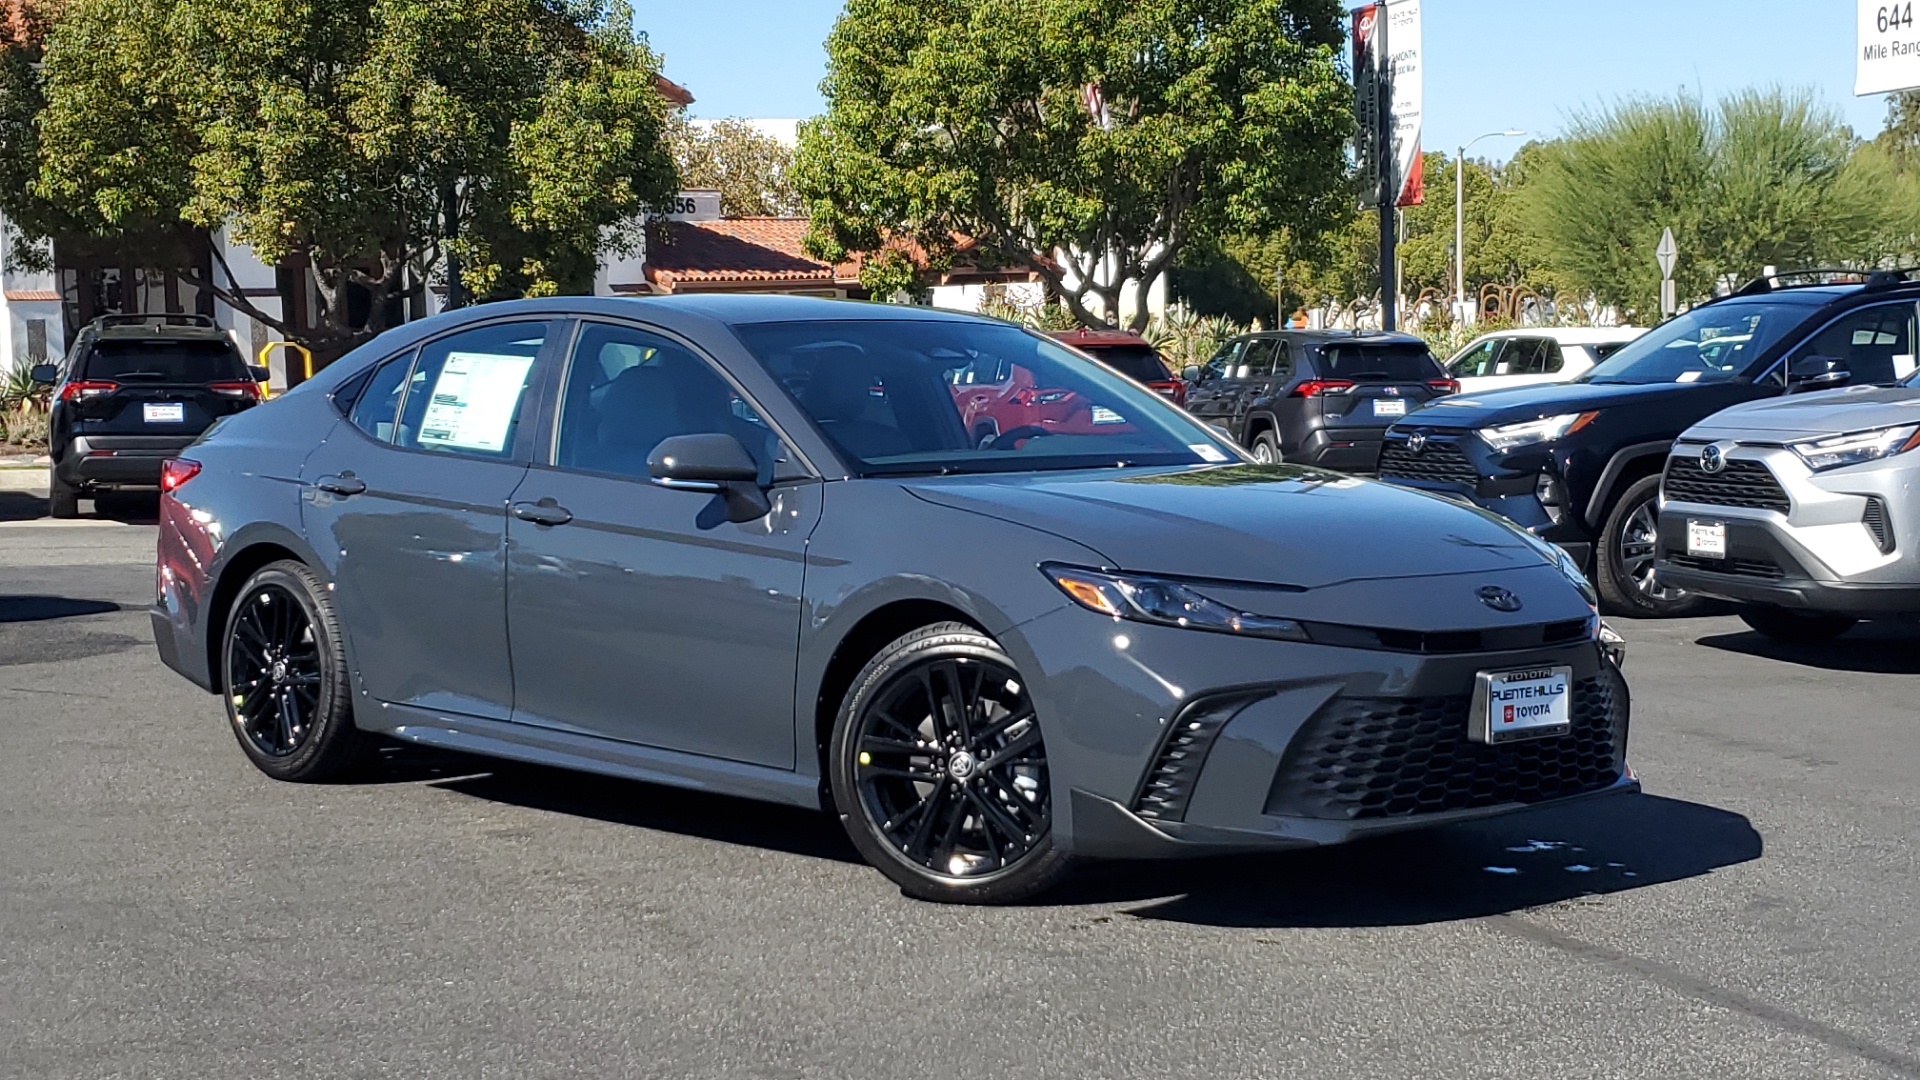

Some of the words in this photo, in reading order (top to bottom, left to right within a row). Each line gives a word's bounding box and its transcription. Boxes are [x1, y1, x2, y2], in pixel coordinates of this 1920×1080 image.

[1877, 1, 1913, 33] 644
[1863, 44, 1888, 61] Mile
[1509, 669, 1552, 681] TOYOTA
[1491, 686, 1532, 702] PUENTE
[1534, 683, 1564, 697] HILLS
[1516, 703, 1551, 718] TOYOTA
